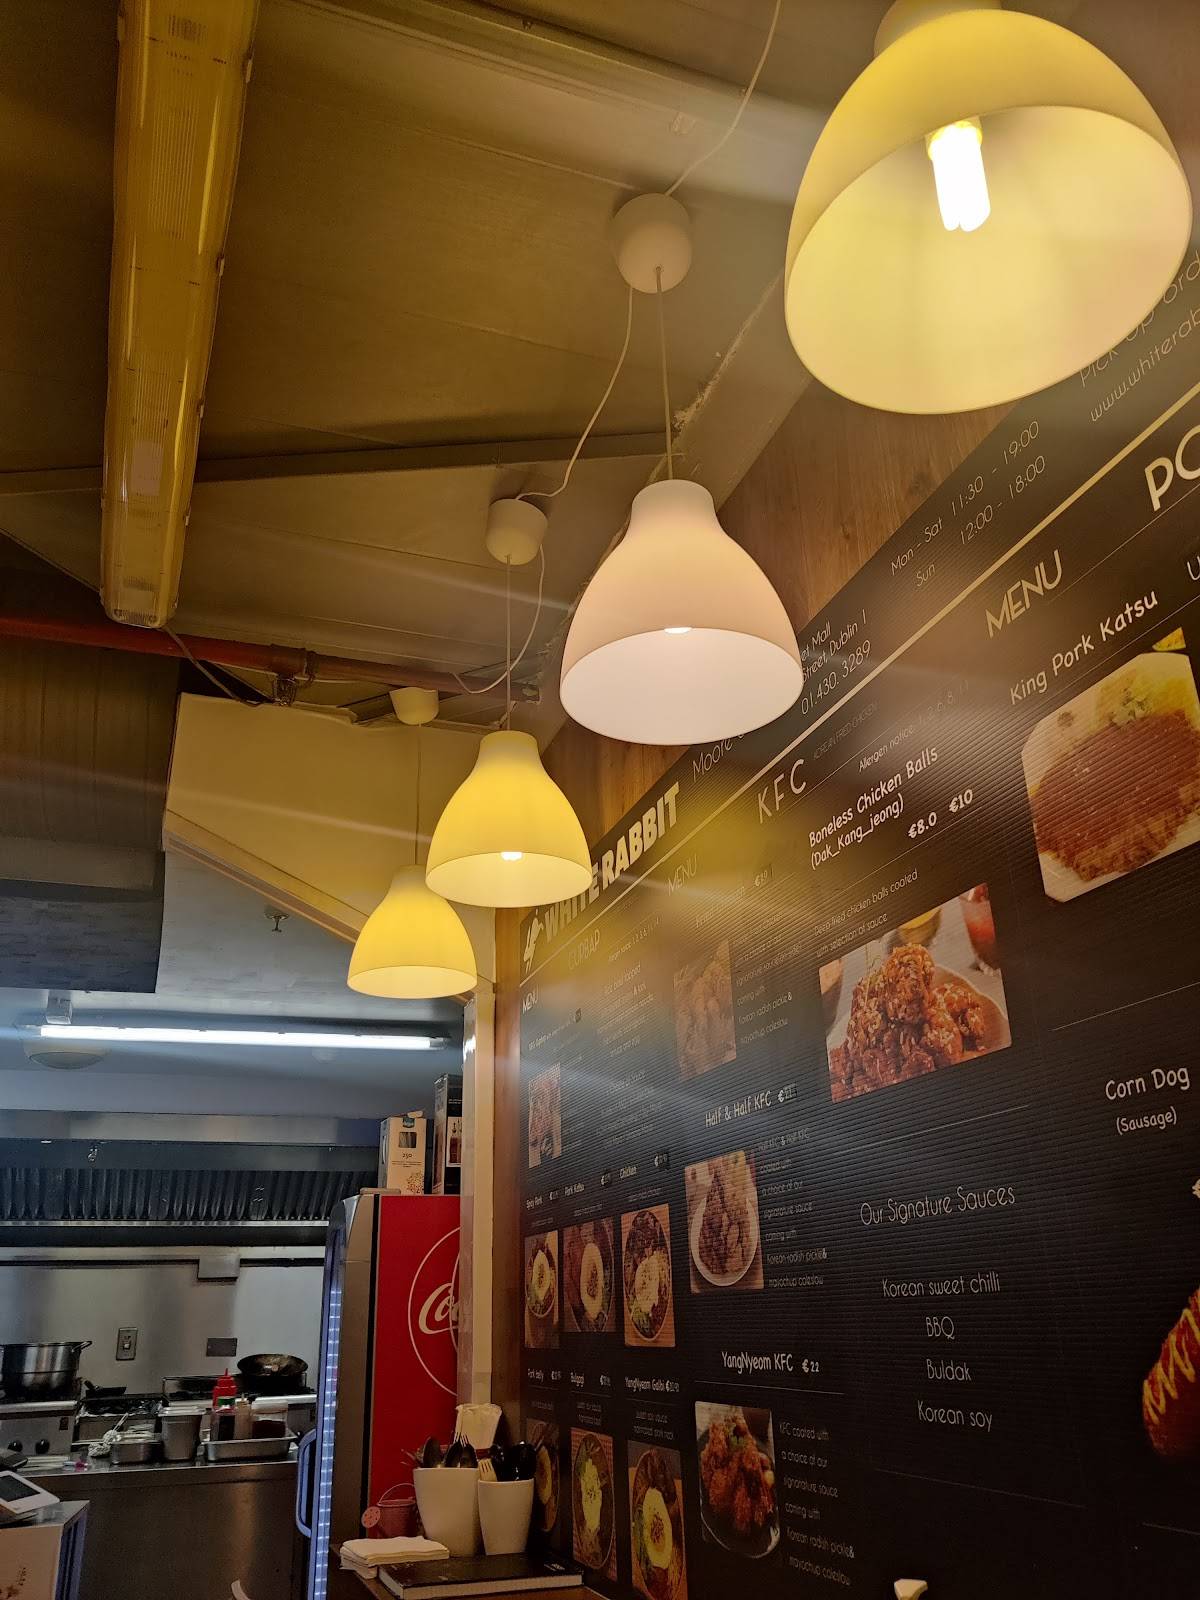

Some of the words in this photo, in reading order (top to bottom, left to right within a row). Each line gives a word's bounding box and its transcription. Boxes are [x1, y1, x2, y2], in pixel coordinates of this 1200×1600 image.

[891, 549, 914, 576] Mon
[924, 517, 943, 543] Sat
[952, 475, 984, 517] 11:30
[1004, 420, 1039, 465] 19:00
[916, 562, 936, 587] Sun
[960, 504, 994, 545] 12:00
[1009, 455, 1046, 499] 18:00
[985, 549, 1063, 638] MENU
[811, 621, 831, 650] Mall
[830, 623, 858, 657] Dublin
[1010, 670, 1049, 705] King
[1051, 634, 1095, 676] Pork
[1099, 590, 1158, 642] Katsu
[842, 639, 871, 678] 3289
[859, 745, 888, 773] Allergen
[809, 808, 854, 848] Boneless
[856, 773, 902, 813] Chicken
[905, 747, 938, 780] Balls
[948, 789, 974, 813] €10
[602, 781, 680, 890] RABBIT
[668, 855, 698, 896] MENU
[872, 885, 889, 904] balls
[867, 913, 888, 930] sauce
[1105, 1077, 1146, 1100] Corn
[1151, 1067, 1190, 1091] Dog
[705, 1107, 722, 1128] Half
[725, 1105, 732, 1121] &
[734, 1095, 752, 1117] Half
[754, 1090, 772, 1111] KFC
[1117, 1106, 1177, 1135] (Sausage)
[860, 1202, 884, 1225] Our
[887, 1195, 953, 1224] Signature
[957, 1186, 1015, 1212] Sauces
[882, 1278, 925, 1297] Korean
[929, 1276, 964, 1296] sweet
[970, 1271, 1001, 1293] chilli
[925, 1316, 955, 1340] BBQ
[722, 1352, 772, 1375] YangNyeom
[773, 1354, 794, 1372] KFC
[926, 1358, 972, 1381] Buldak
[918, 1400, 965, 1425] Korean
[970, 1410, 993, 1433] soy
